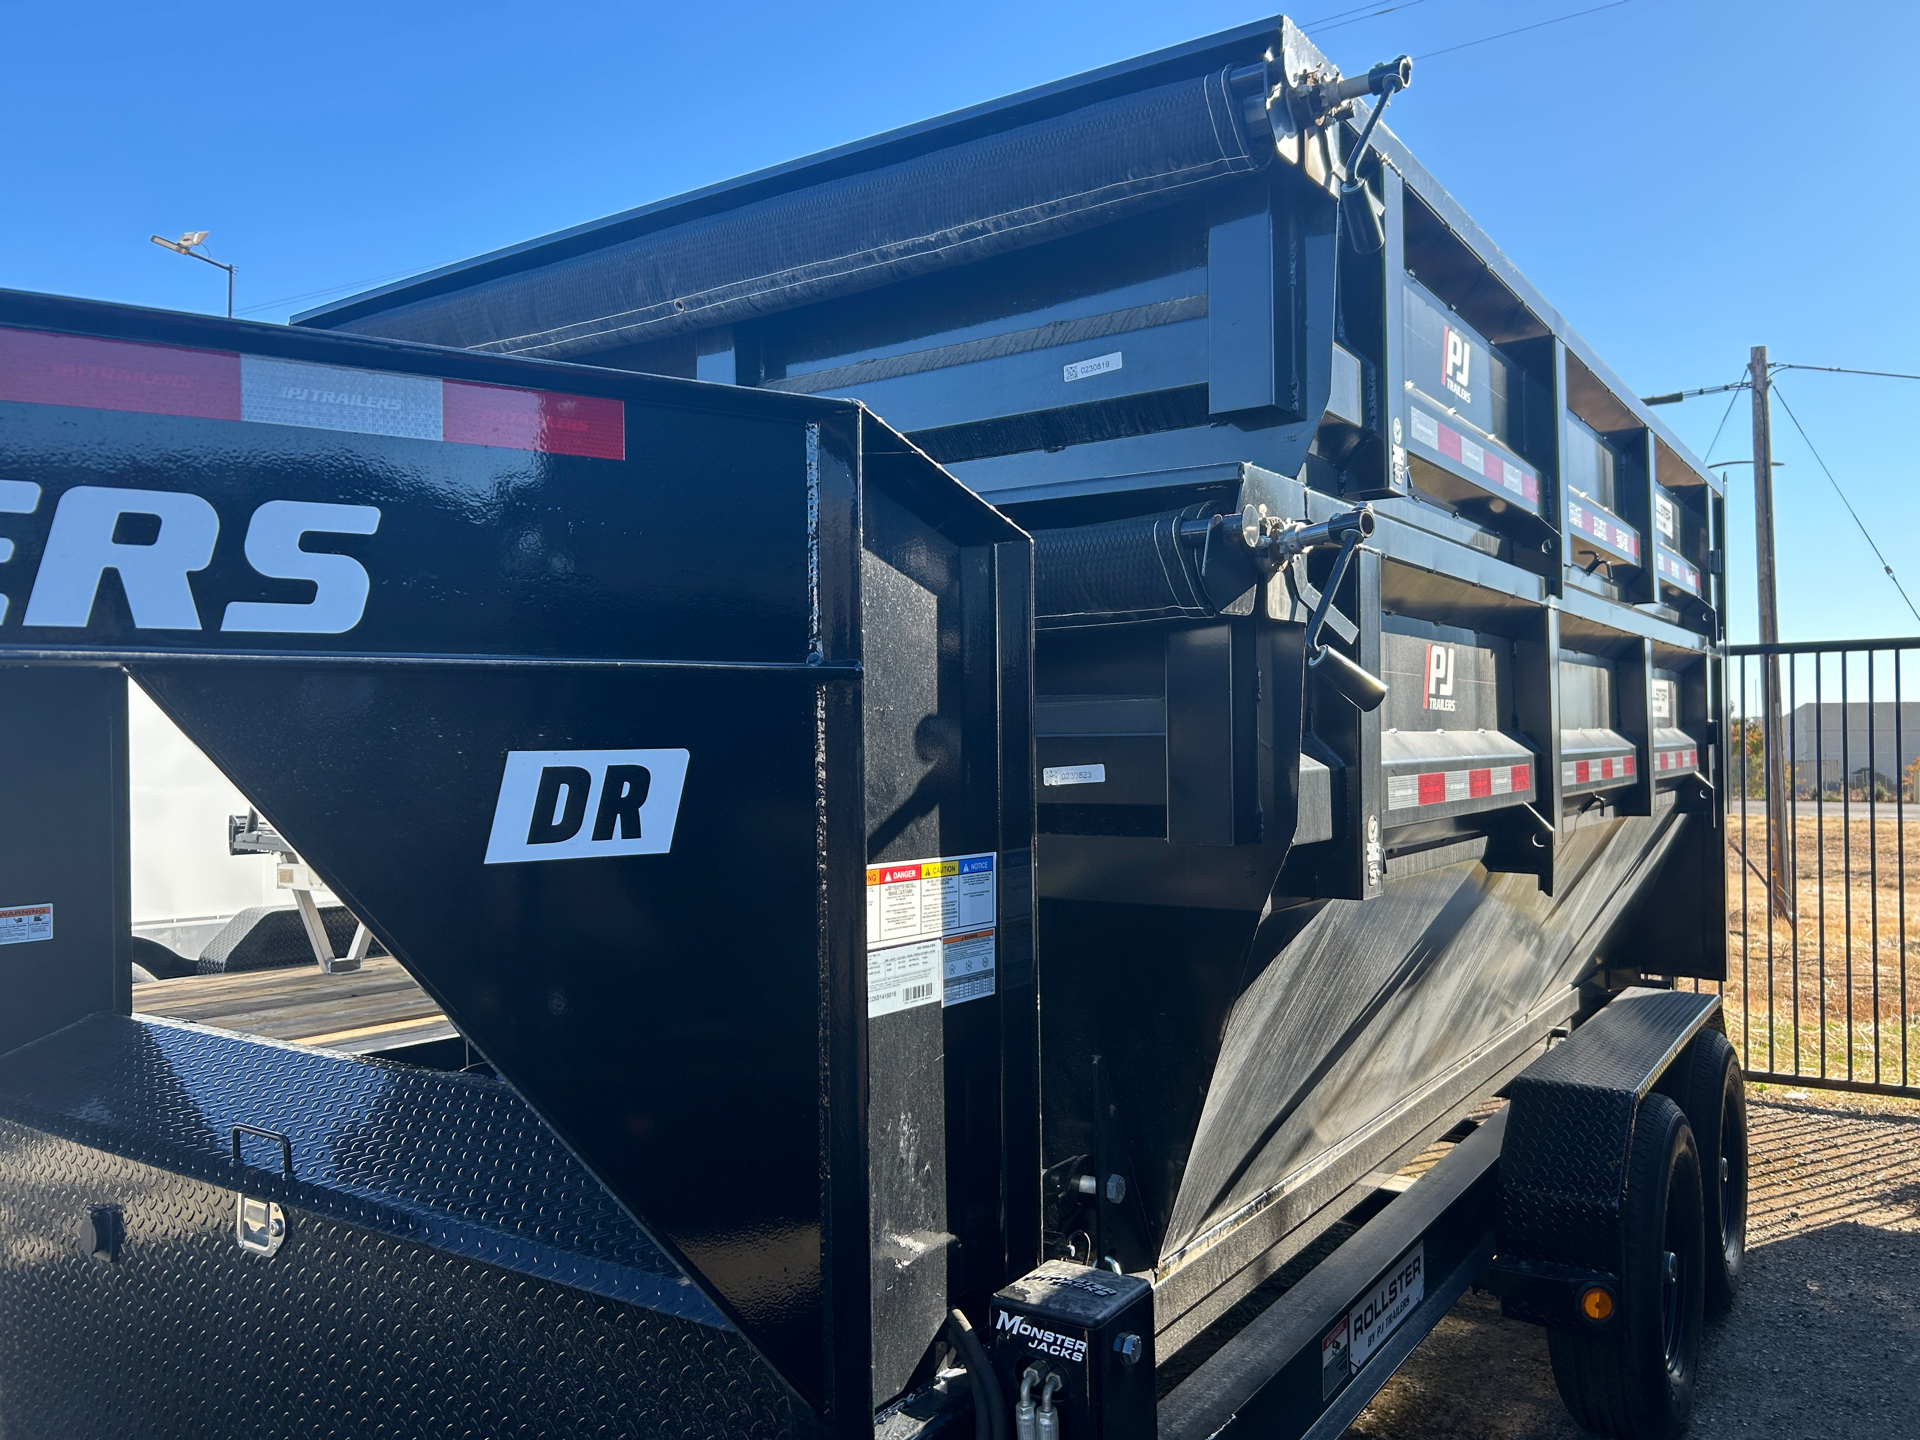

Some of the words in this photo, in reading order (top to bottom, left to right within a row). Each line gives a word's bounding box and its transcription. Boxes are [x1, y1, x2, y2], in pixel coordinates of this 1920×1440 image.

[1446, 330, 1470, 387] PJ
[311, 389, 401, 411] TRAILERS
[0, 479, 381, 633] RS
[1429, 645, 1455, 696] PJ
[1429, 697, 1456, 711] TRAILERS
[526, 764, 651, 845] DR
[893, 869, 916, 880] DANGER
[933, 865, 956, 875] CAUTION
[971, 861, 988, 870] NOTICE
[1353, 1255, 1421, 1342] ROLLSTER
[1367, 1330, 1376, 1348] BY
[1376, 1324, 1385, 1339] PJ
[1385, 1294, 1411, 1330] TRAILERS
[1028, 1340, 1083, 1363] JACKS
